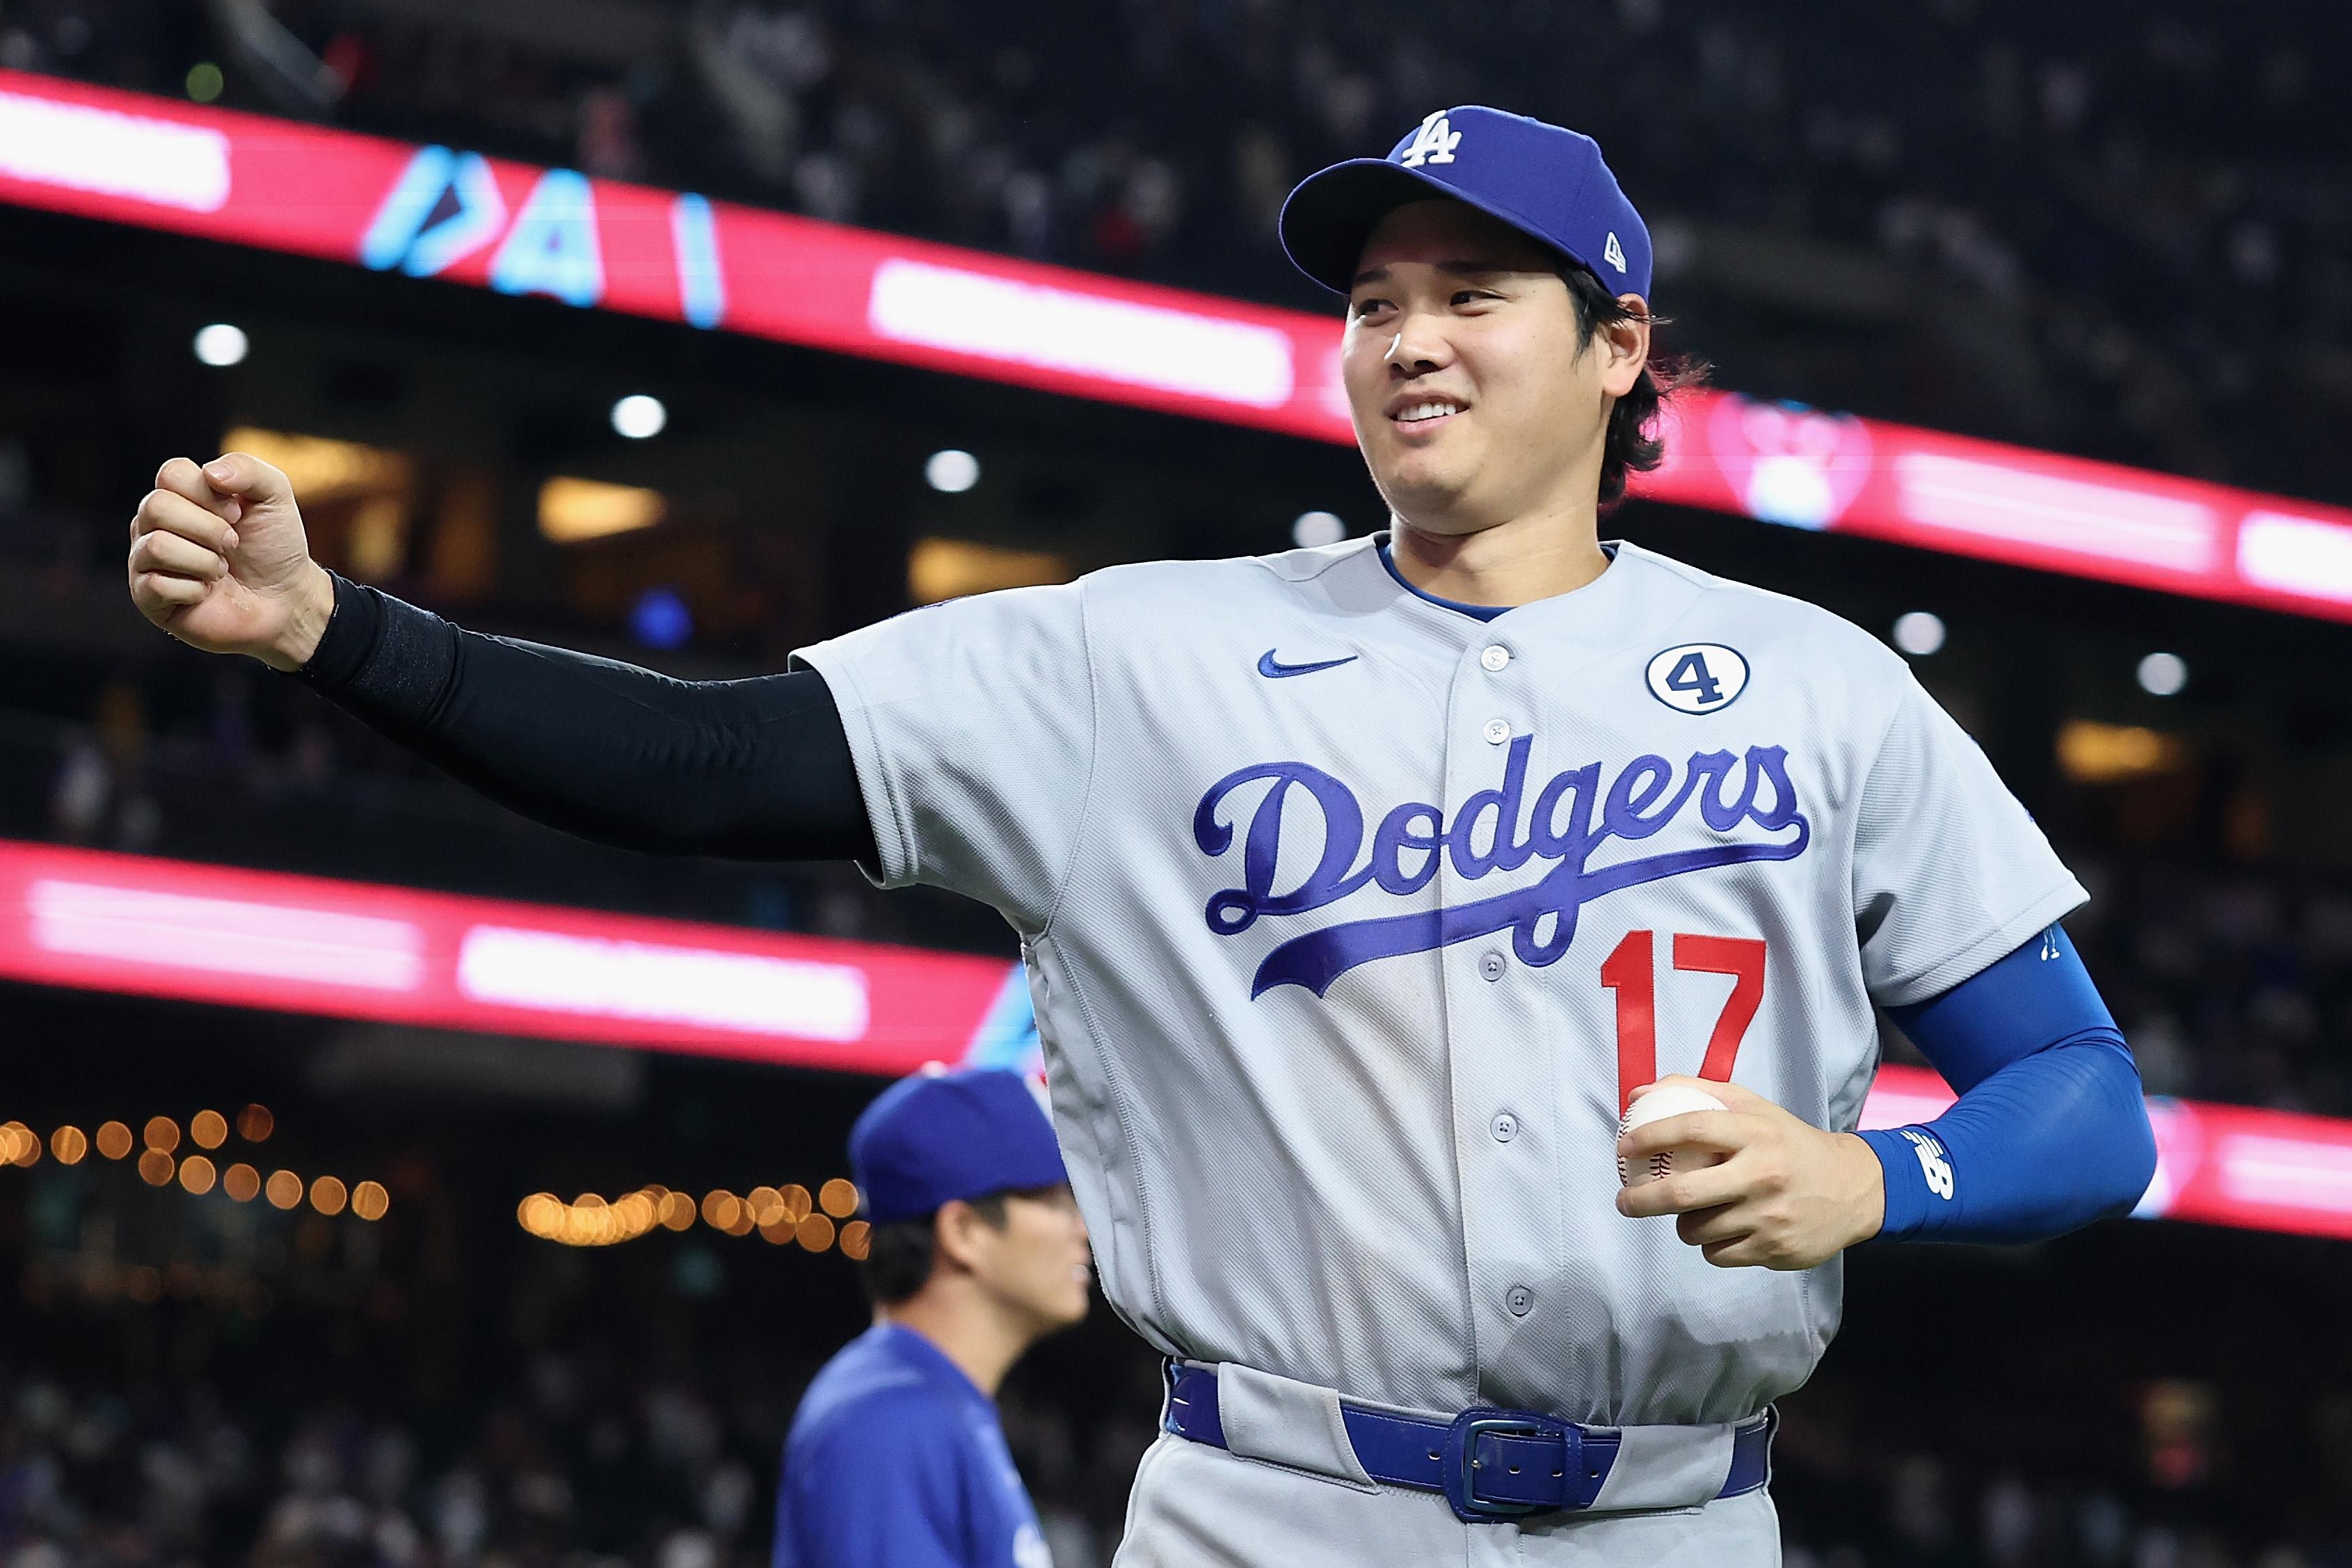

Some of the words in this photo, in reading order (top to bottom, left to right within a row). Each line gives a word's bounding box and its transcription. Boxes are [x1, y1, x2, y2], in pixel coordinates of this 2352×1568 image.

[1401, 109, 1462, 168] LA
[1665, 652, 1724, 705] 4
[1194, 733, 1809, 968] Dodgers
[1601, 930, 1766, 1120] 17
